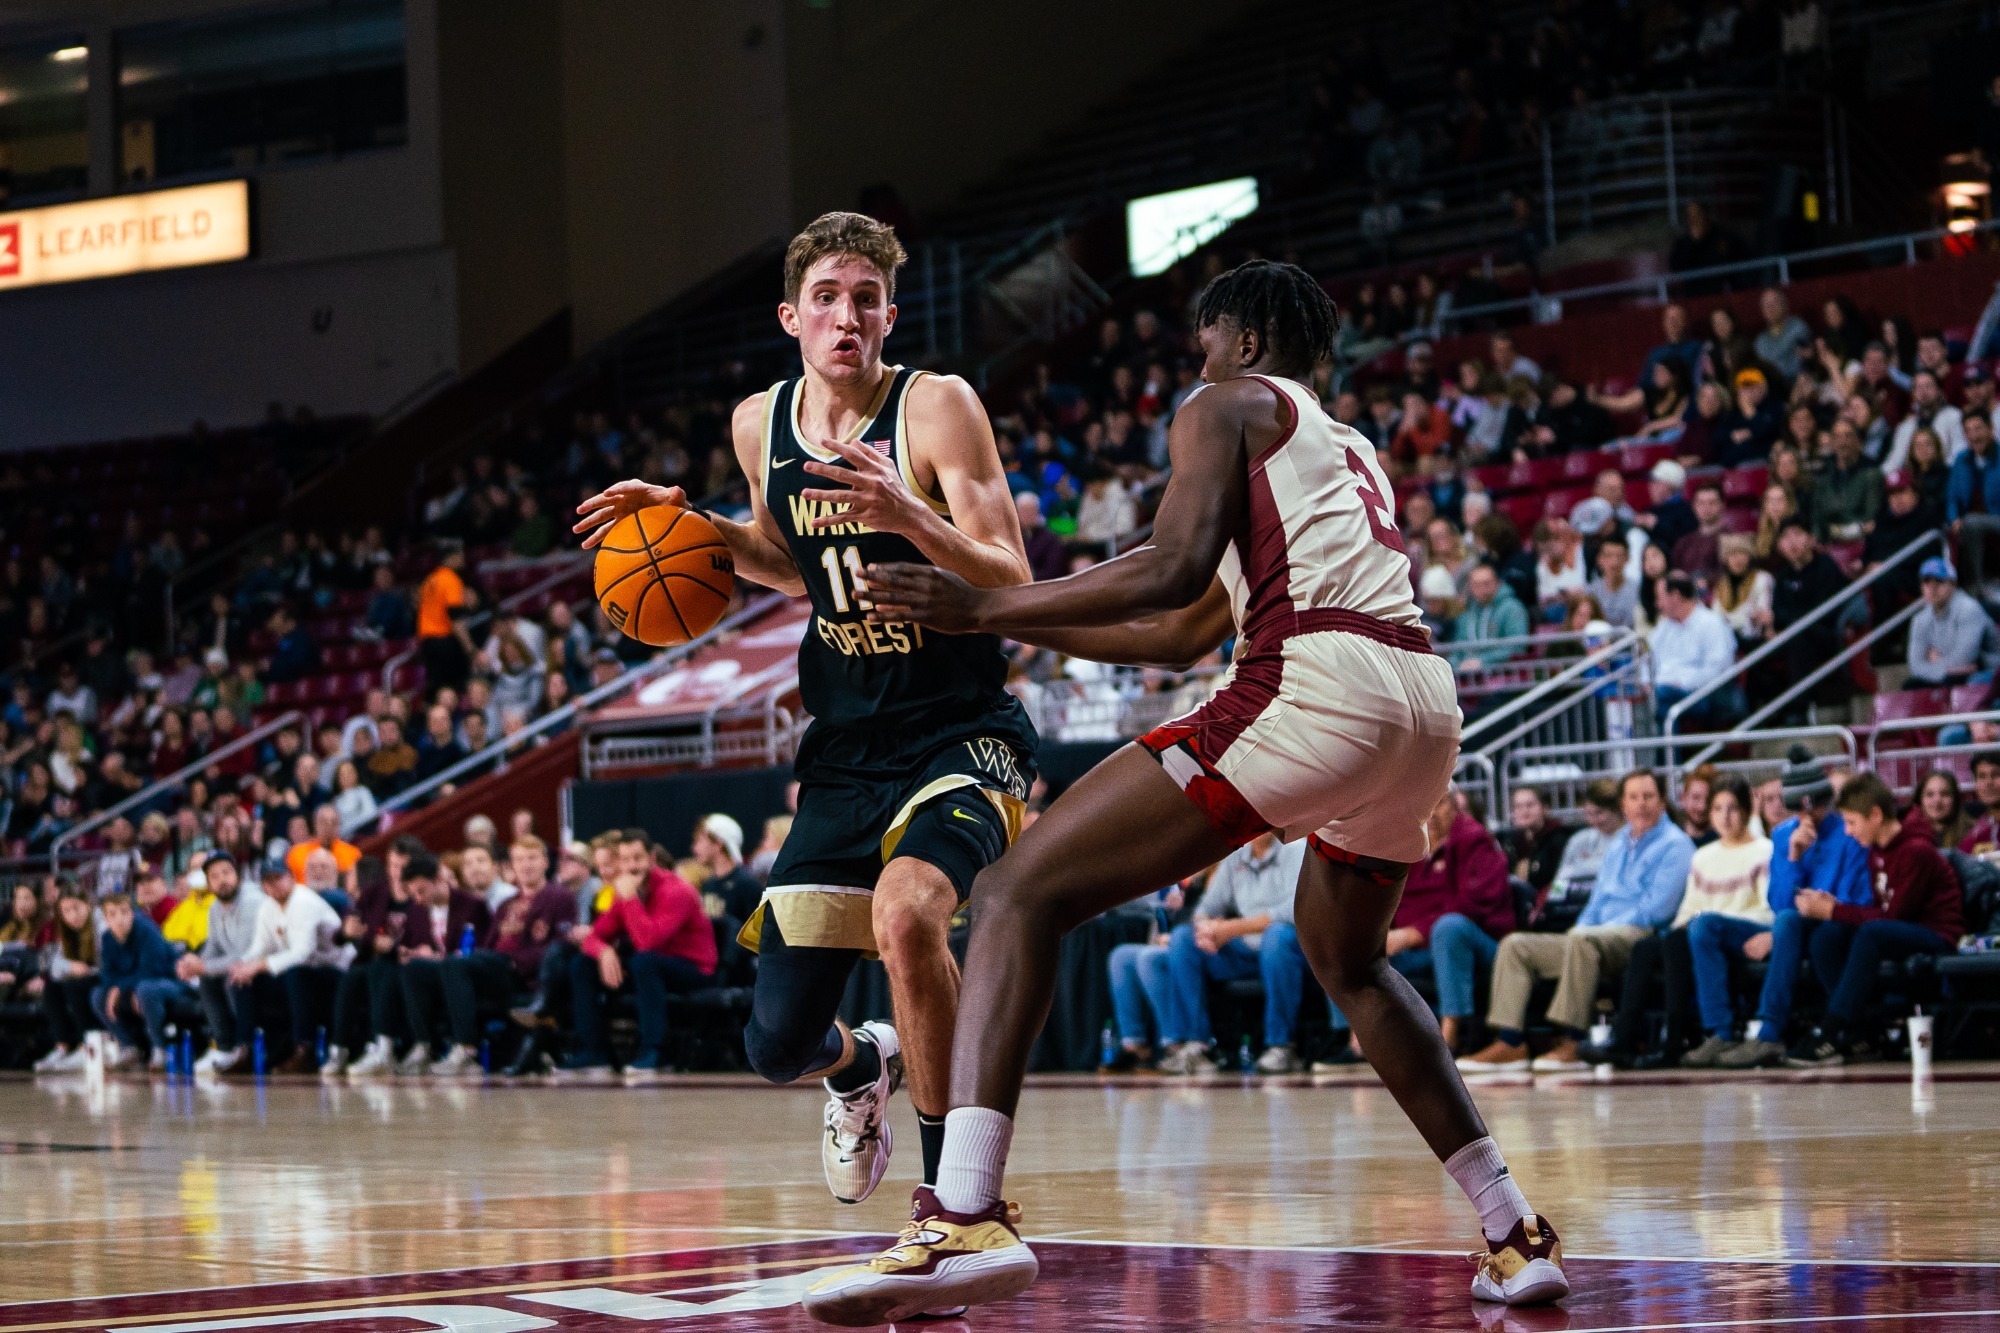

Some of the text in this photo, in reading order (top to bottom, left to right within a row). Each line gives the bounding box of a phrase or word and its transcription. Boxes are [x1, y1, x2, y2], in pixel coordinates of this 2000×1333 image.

[39, 211, 210, 258] LEARFIELD
[1345, 445, 1407, 555] 2
[821, 545, 874, 613] 11
